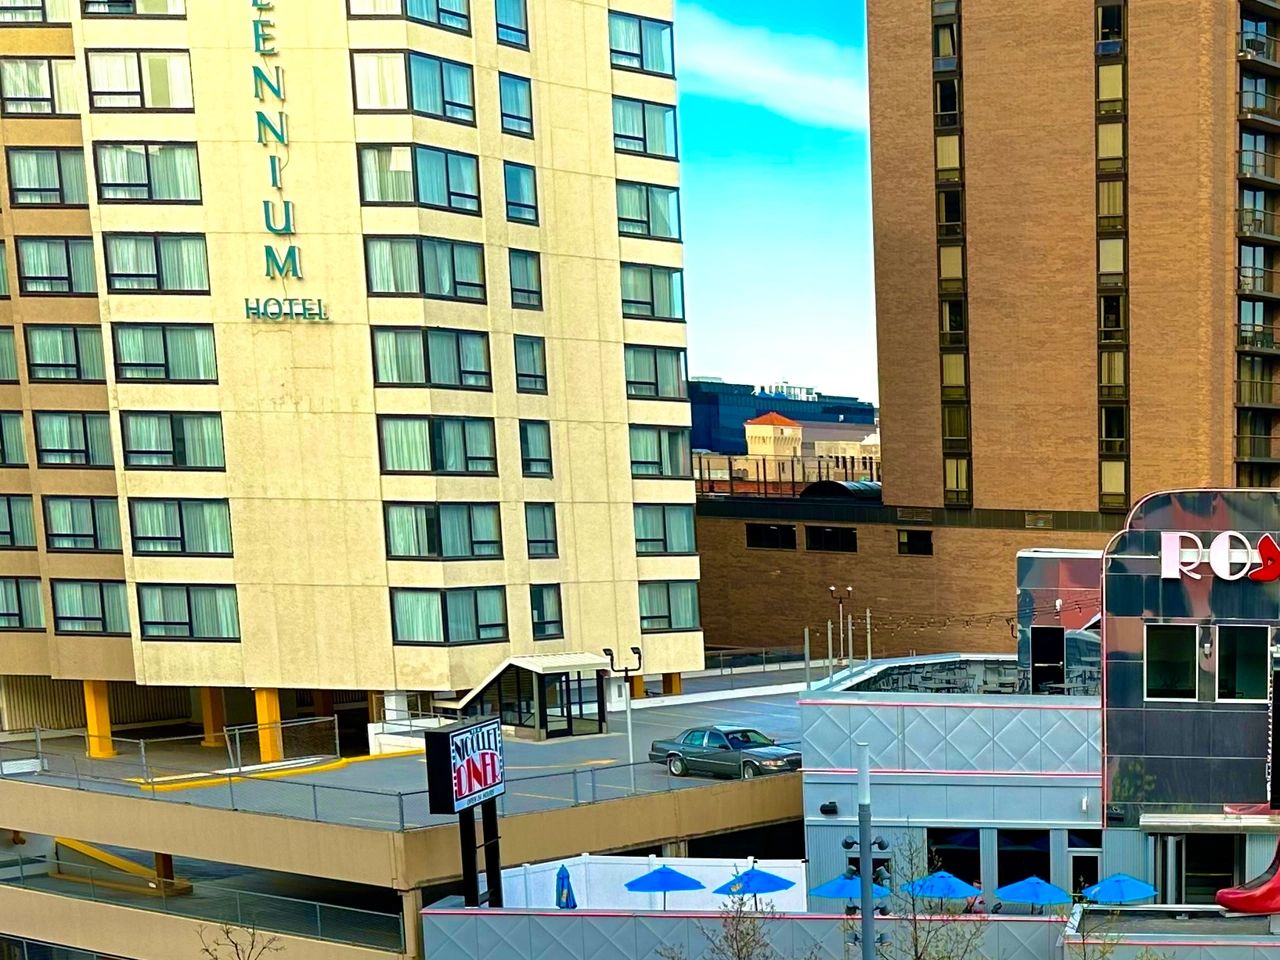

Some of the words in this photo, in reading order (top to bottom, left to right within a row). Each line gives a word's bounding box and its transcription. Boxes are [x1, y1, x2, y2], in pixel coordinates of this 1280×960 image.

[252, 0, 303, 279] ENNIUM
[244, 297, 329, 321] HOTEL
[456, 751, 501, 798] DINER
